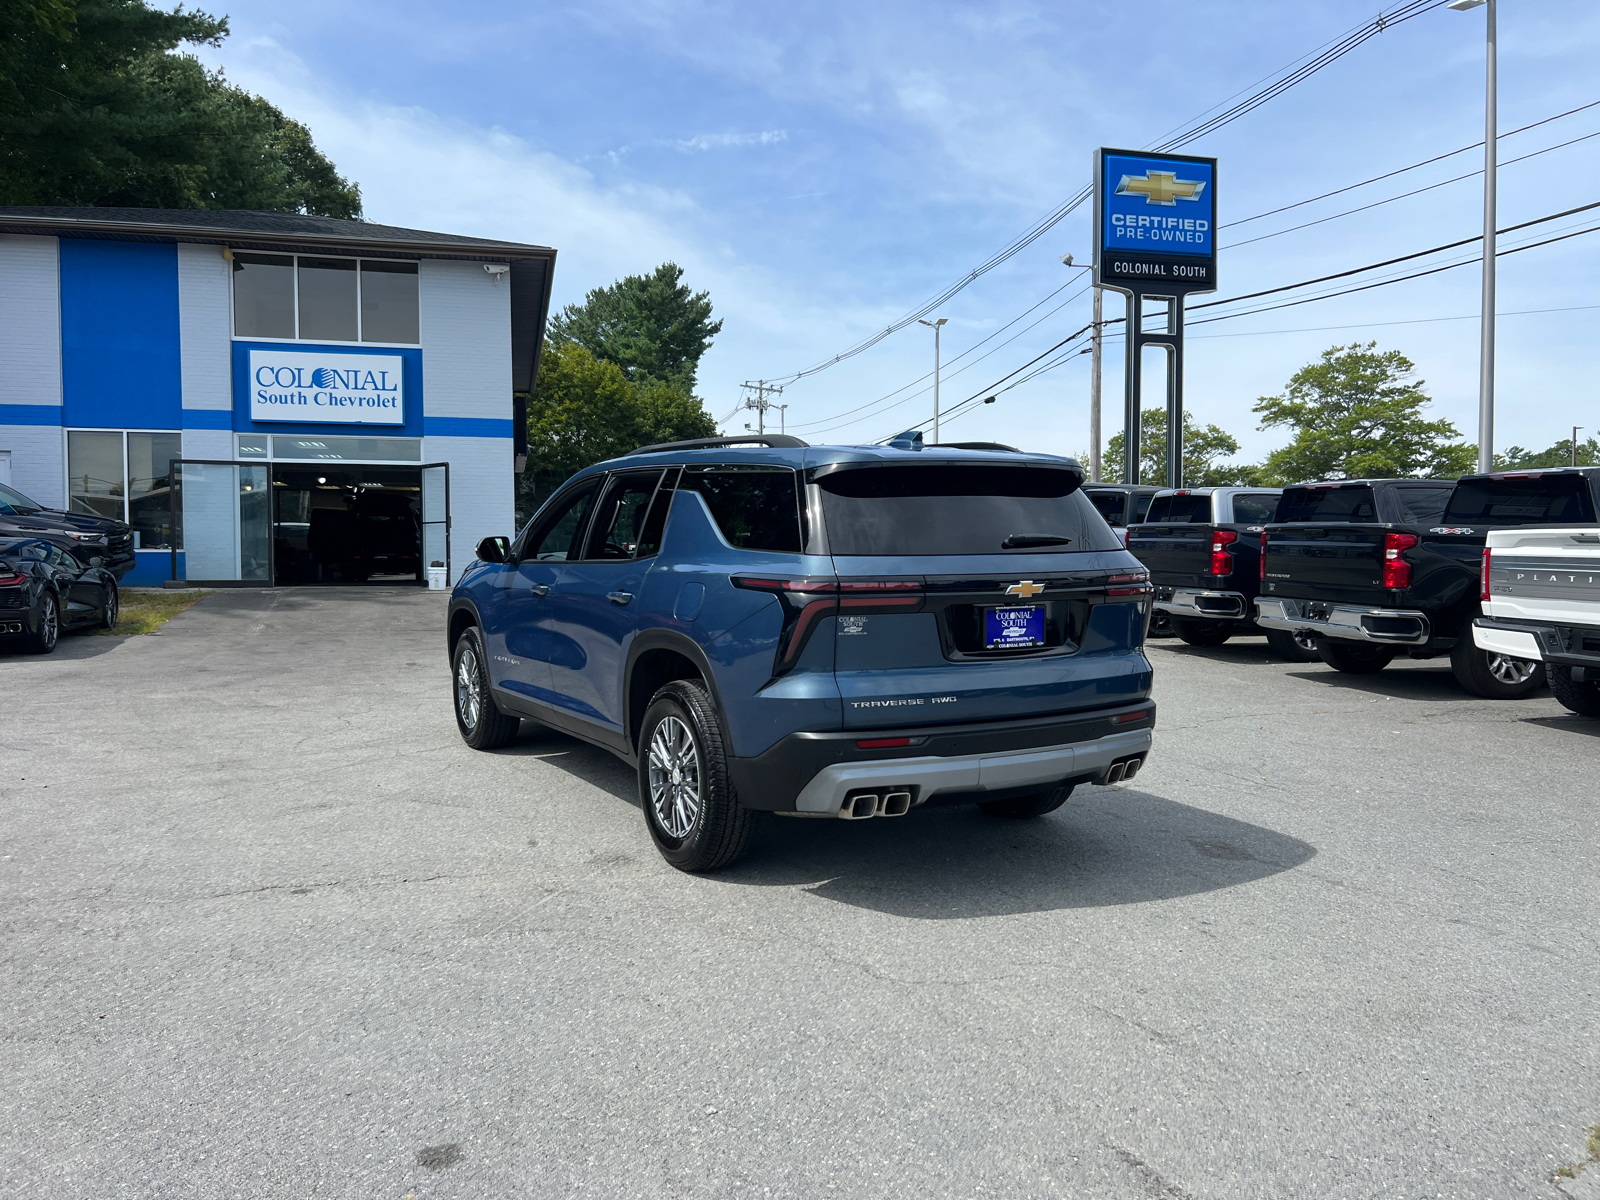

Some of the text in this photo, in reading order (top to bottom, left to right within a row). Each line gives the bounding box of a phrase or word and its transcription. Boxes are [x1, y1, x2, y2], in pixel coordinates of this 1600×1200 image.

[1111, 213, 1209, 231] CERTIFIED
[1116, 227, 1204, 243] PRE-OWNED
[1114, 261, 1206, 277] COLONIAL SOUTH
[255, 366, 397, 391] COLONIAL
[257, 389, 397, 408] South Chevrolet
[1001, 619, 1027, 627] SOUTH
[851, 696, 957, 708] TRAVERSE AWD
